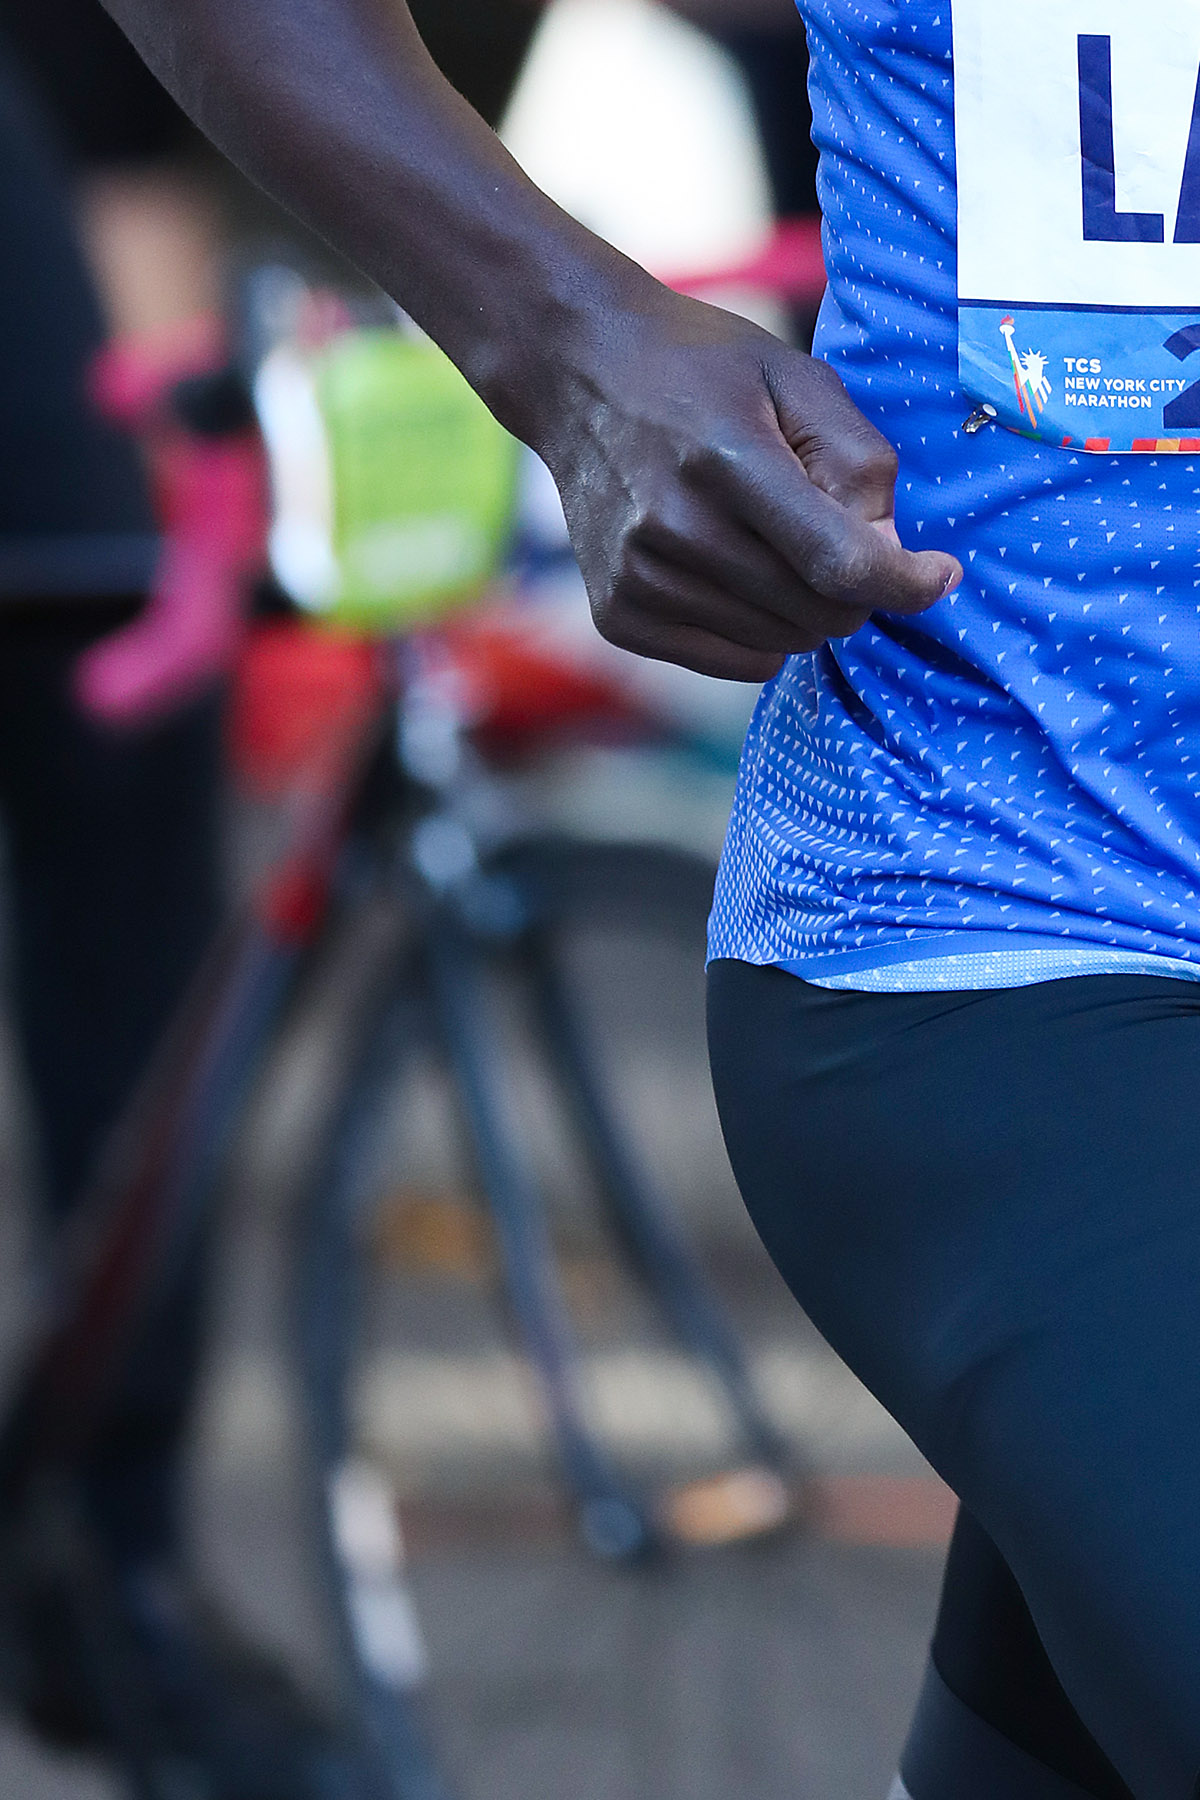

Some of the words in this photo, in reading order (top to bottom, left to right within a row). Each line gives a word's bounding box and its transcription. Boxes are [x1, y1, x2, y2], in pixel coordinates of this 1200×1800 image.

[1063, 357, 1102, 374] TCS
[1064, 376, 1101, 391] NEW
[1103, 378, 1147, 392] YORK
[1149, 379, 1186, 392] CITY
[1064, 393, 1152, 409] MARATHON
